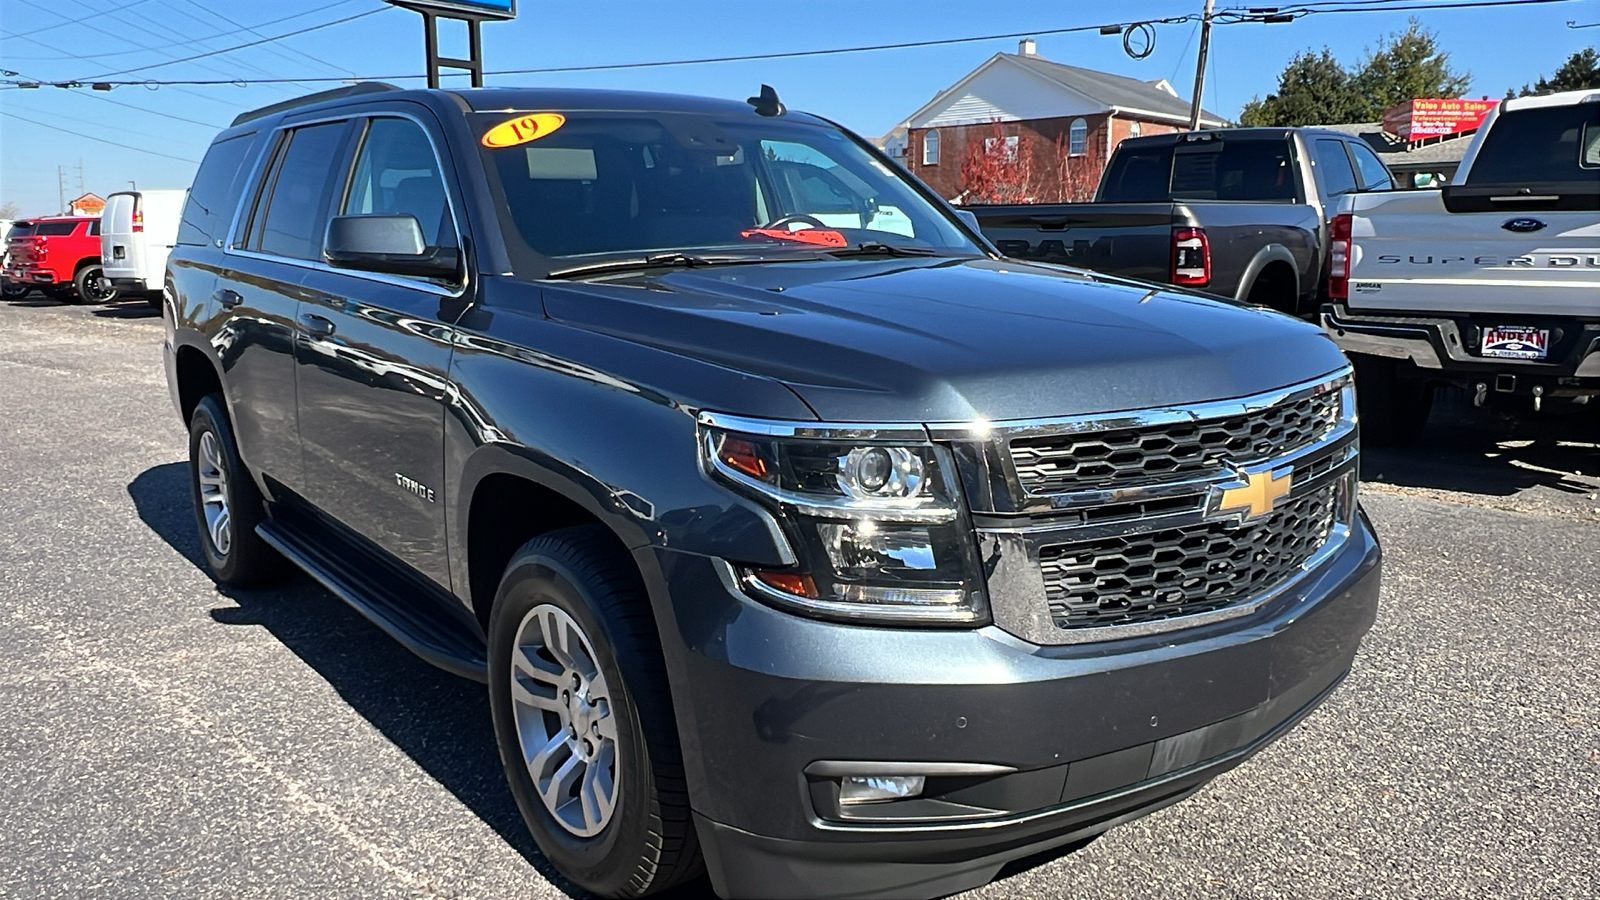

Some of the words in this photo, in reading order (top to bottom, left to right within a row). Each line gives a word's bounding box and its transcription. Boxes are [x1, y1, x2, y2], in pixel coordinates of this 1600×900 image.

[1415, 102, 1438, 110] Value
[1441, 102, 1460, 110] Auto
[510, 118, 538, 140] 19
[1378, 254, 1535, 266] SUPER
[1485, 329, 1546, 350] ANDEAN
[395, 472, 435, 503] TAHOE
